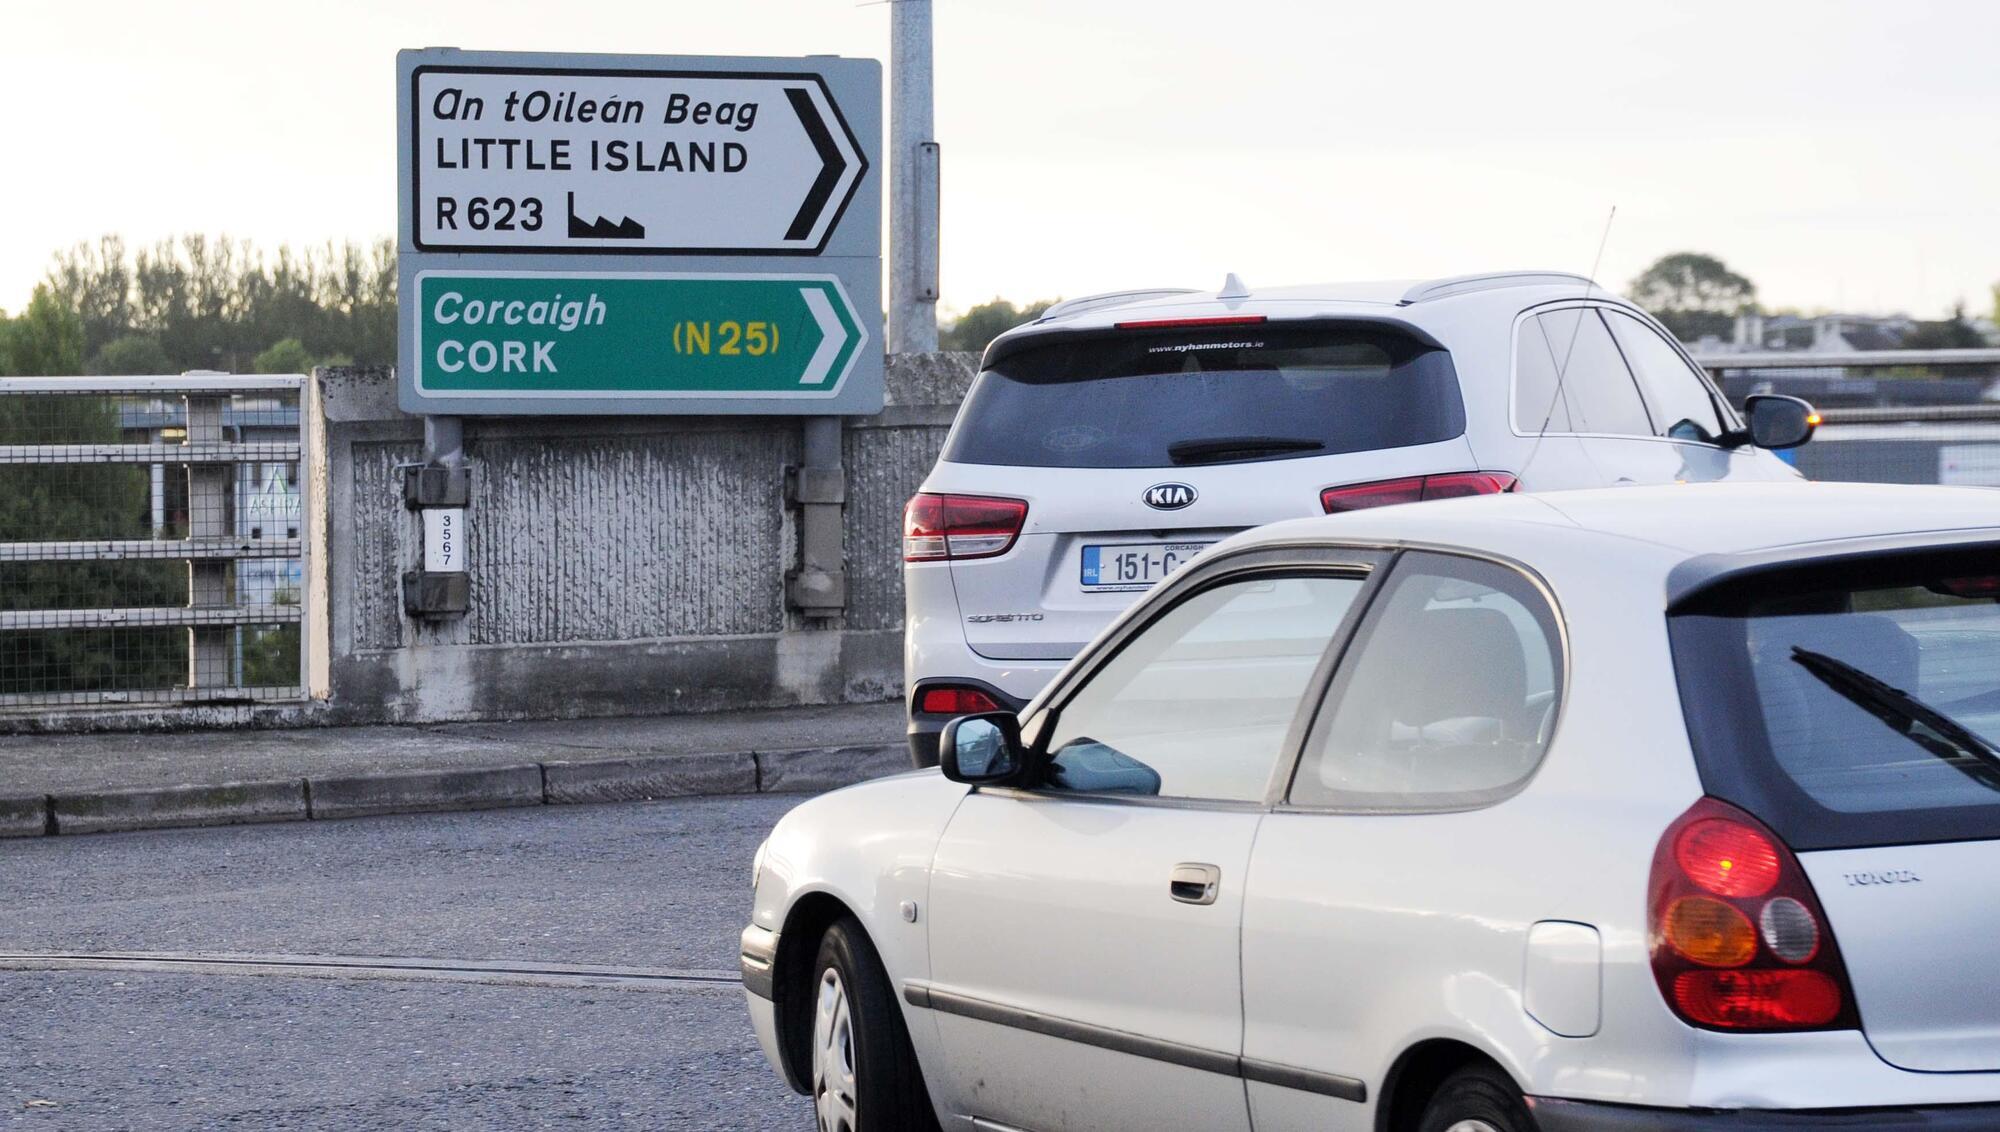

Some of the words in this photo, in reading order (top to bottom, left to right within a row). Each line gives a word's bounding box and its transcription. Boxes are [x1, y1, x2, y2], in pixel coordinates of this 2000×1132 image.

[433, 88, 484, 121] An
[504, 90, 644, 125] tOileán
[663, 93, 759, 131] Beag
[436, 138, 572, 170] LITTLE
[591, 140, 748, 173] ISLAND
[433, 292, 607, 332] Corcaigh
[436, 340, 558, 373] CORK
[1148, 341, 1264, 353] www.nyhanmotors.ie
[1151, 487, 1188, 504] KIA
[1083, 568, 1098, 578] IRL
[1115, 552, 1200, 580] 151-C-
[967, 613, 1044, 623] SORENTO
[1842, 869, 1923, 887] TOYOTA
